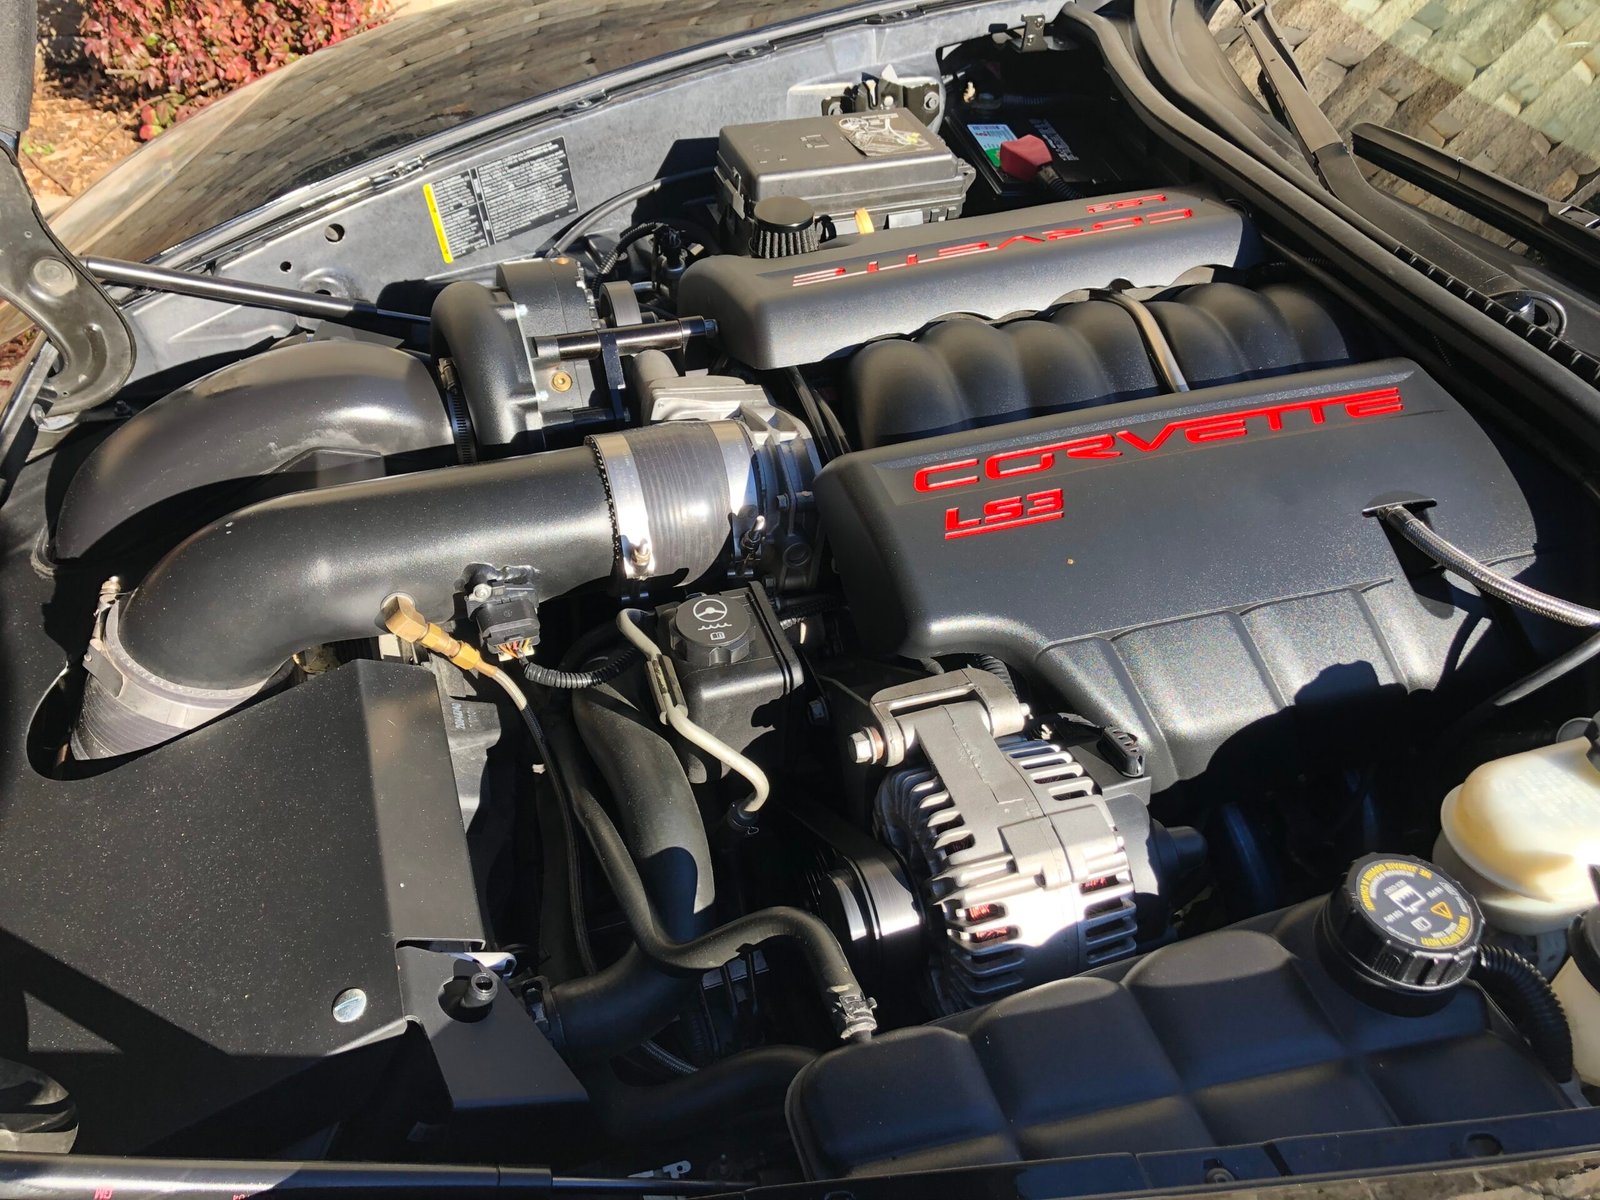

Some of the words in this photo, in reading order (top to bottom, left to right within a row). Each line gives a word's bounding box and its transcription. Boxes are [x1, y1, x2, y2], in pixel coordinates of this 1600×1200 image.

[792, 207, 1193, 287] CORVETTE
[913, 386, 1404, 493] CORVETTE
[945, 488, 1064, 532] LS3
